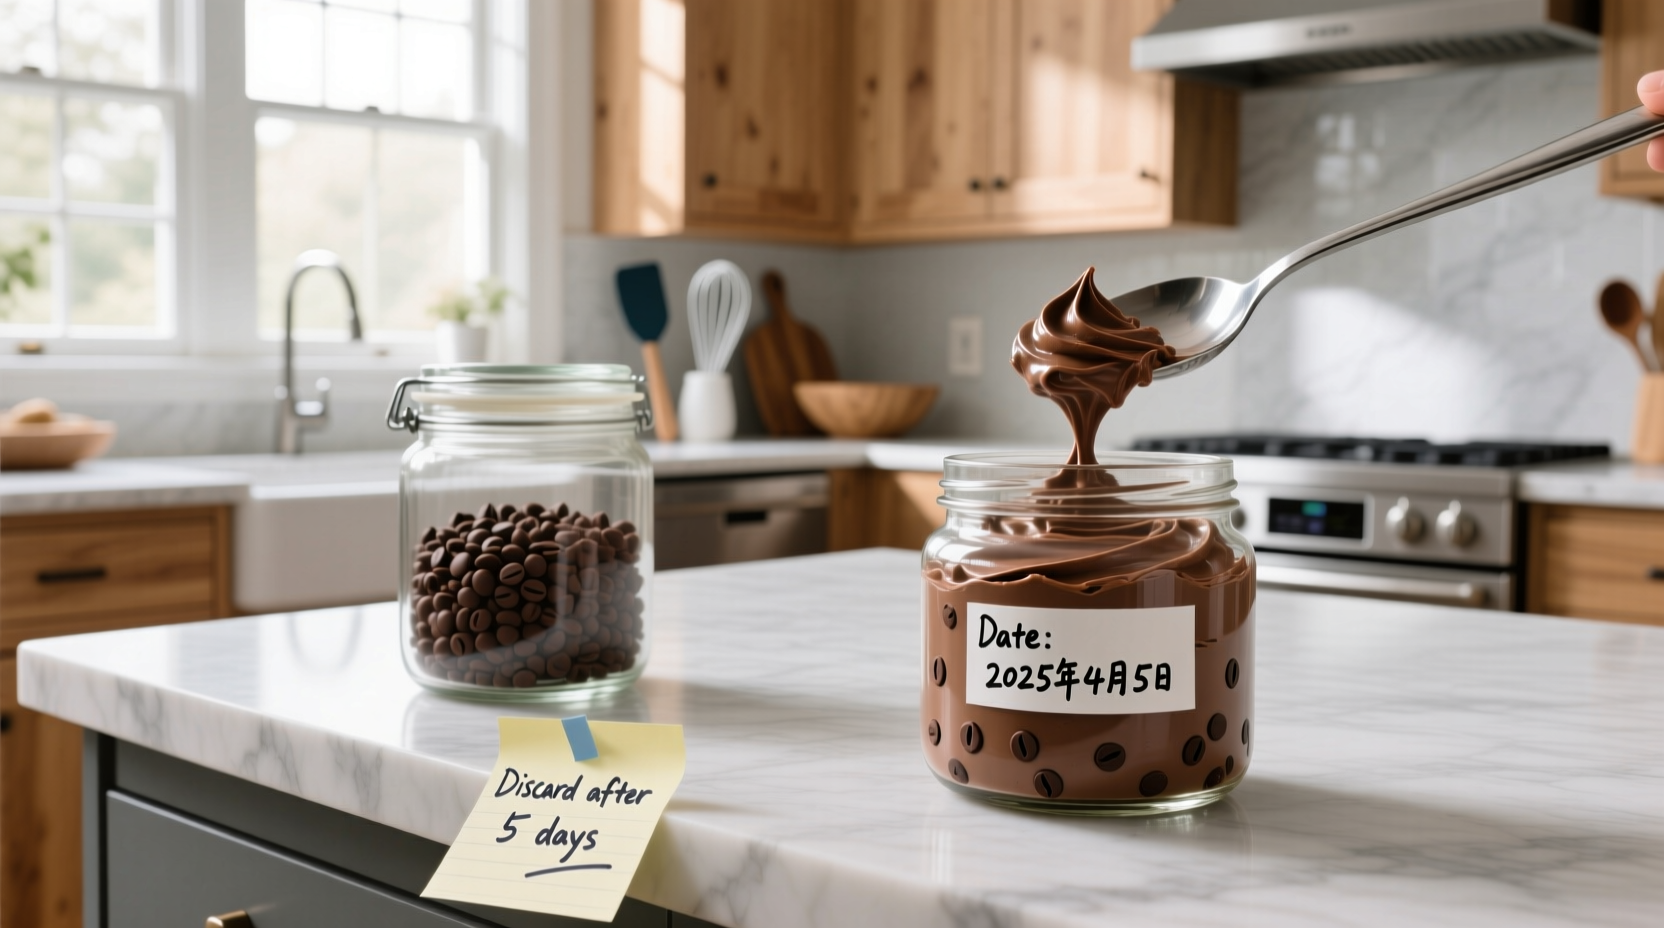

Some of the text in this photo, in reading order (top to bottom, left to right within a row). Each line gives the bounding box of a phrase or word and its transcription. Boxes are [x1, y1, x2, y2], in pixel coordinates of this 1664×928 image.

[978, 613, 1052, 650] Date:
[985, 657, 1172, 702] 2025年4月5日
[494, 767, 653, 808] Discard after
[495, 811, 599, 864] 5 days
